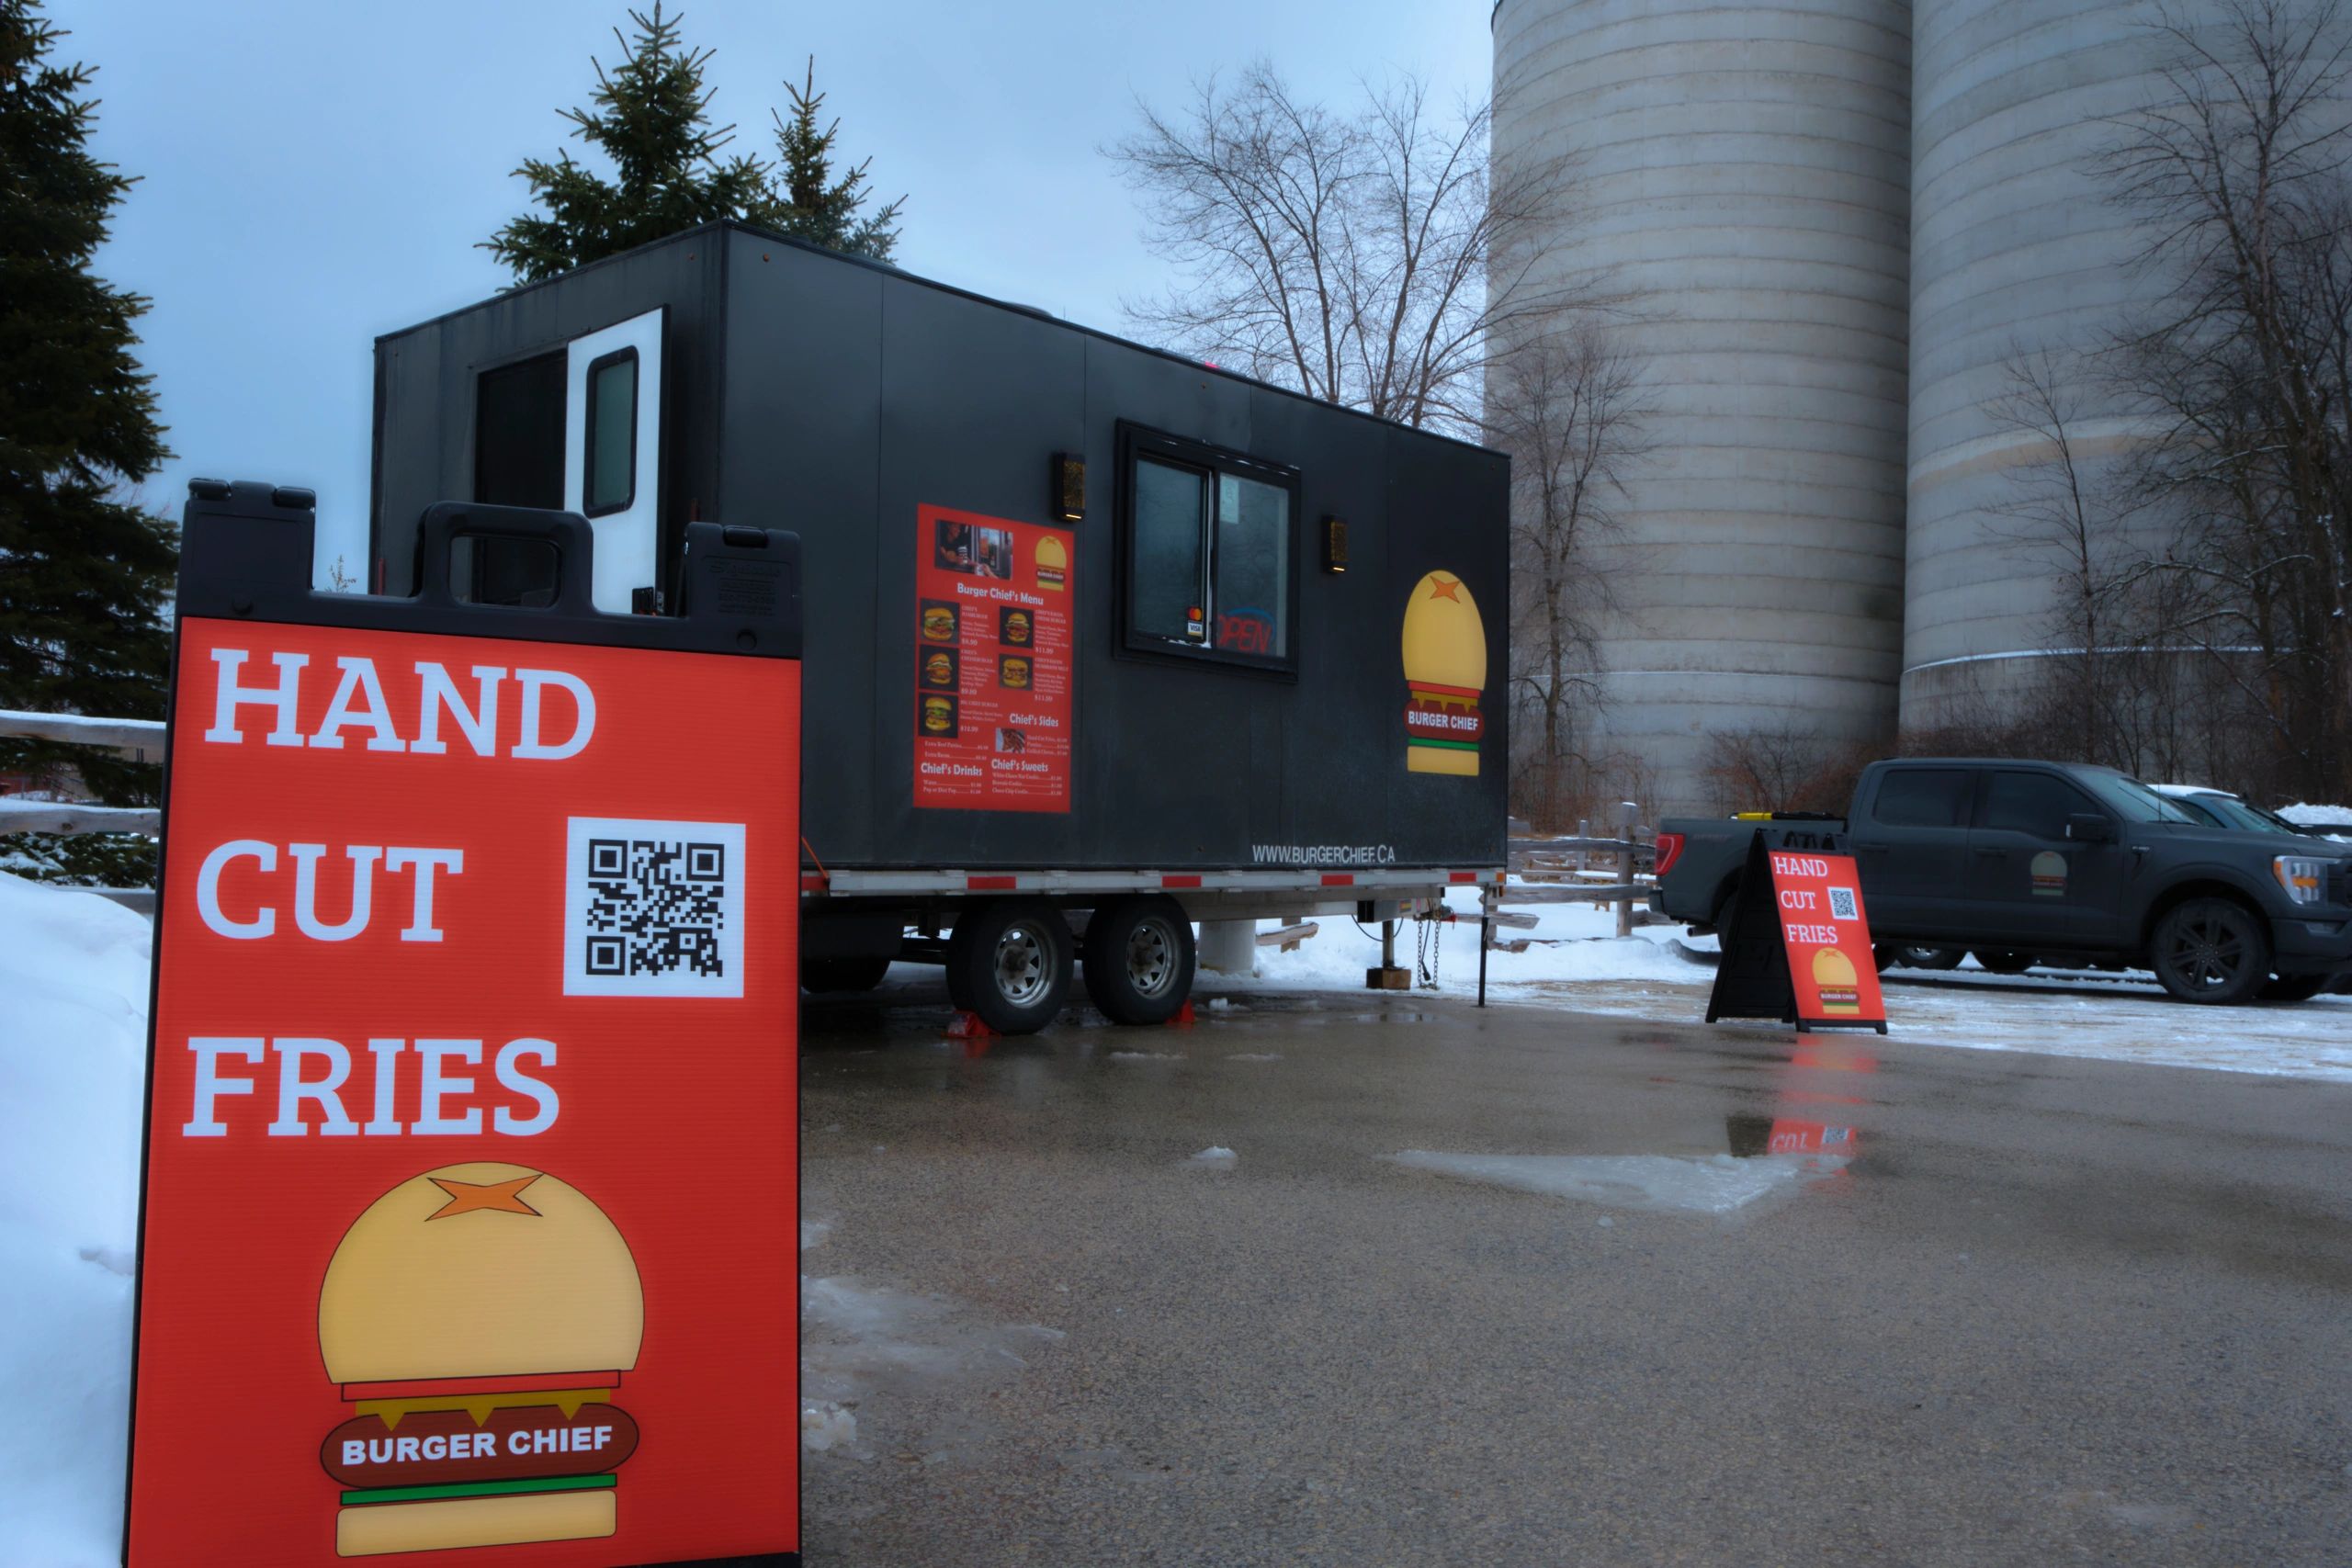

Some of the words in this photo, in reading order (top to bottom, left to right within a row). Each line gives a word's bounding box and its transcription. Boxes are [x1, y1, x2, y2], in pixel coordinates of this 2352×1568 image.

[957, 582, 989, 598] Burger
[990, 587, 1018, 602] Chief's
[1020, 592, 1044, 605] Menu
[205, 648, 596, 760] HAND
[1010, 713, 1036, 726] Chief's
[1039, 716, 1058, 728] Sides
[1408, 711, 1448, 728] BURGER
[1451, 716, 1478, 730] CHIEF
[921, 761, 951, 775] Chief's
[954, 764, 983, 776] Drinks
[991, 759, 1020, 771] Chief's
[1022, 760, 1048, 773] Sweets
[1773, 856, 1828, 877] HAND
[196, 840, 464, 942] CUT
[1781, 890, 1815, 909] CUT
[1786, 924, 1838, 943] FRIES
[183, 1036, 560, 1137] FRIES
[342, 1432, 497, 1465] BURGER
[508, 1426, 613, 1455] CHIEF
